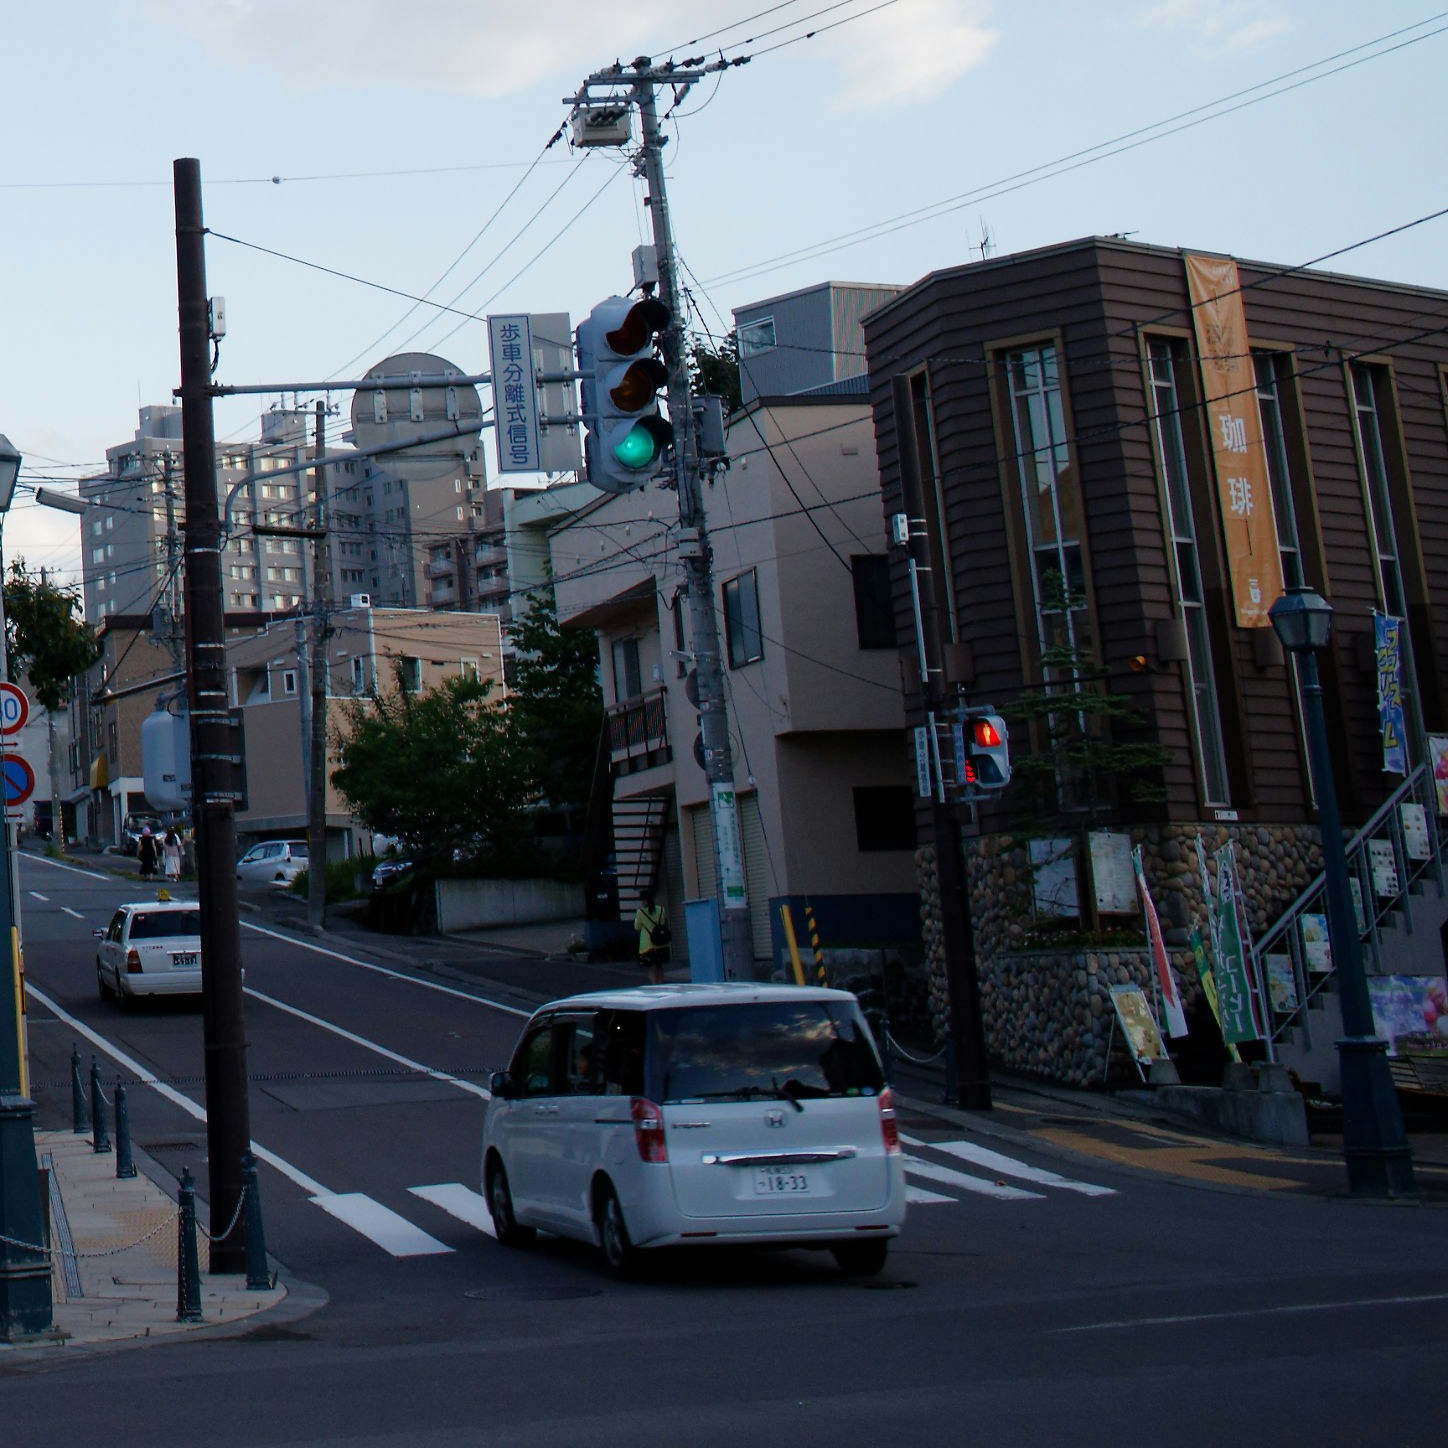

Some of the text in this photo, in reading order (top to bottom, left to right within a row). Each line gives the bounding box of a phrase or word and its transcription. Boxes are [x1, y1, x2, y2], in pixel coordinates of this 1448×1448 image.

[500, 323, 530, 465] 歩車分離式信号
[1219, 414, 1253, 517] 珈琲
[768, 1175, 808, 1191] 18-33
